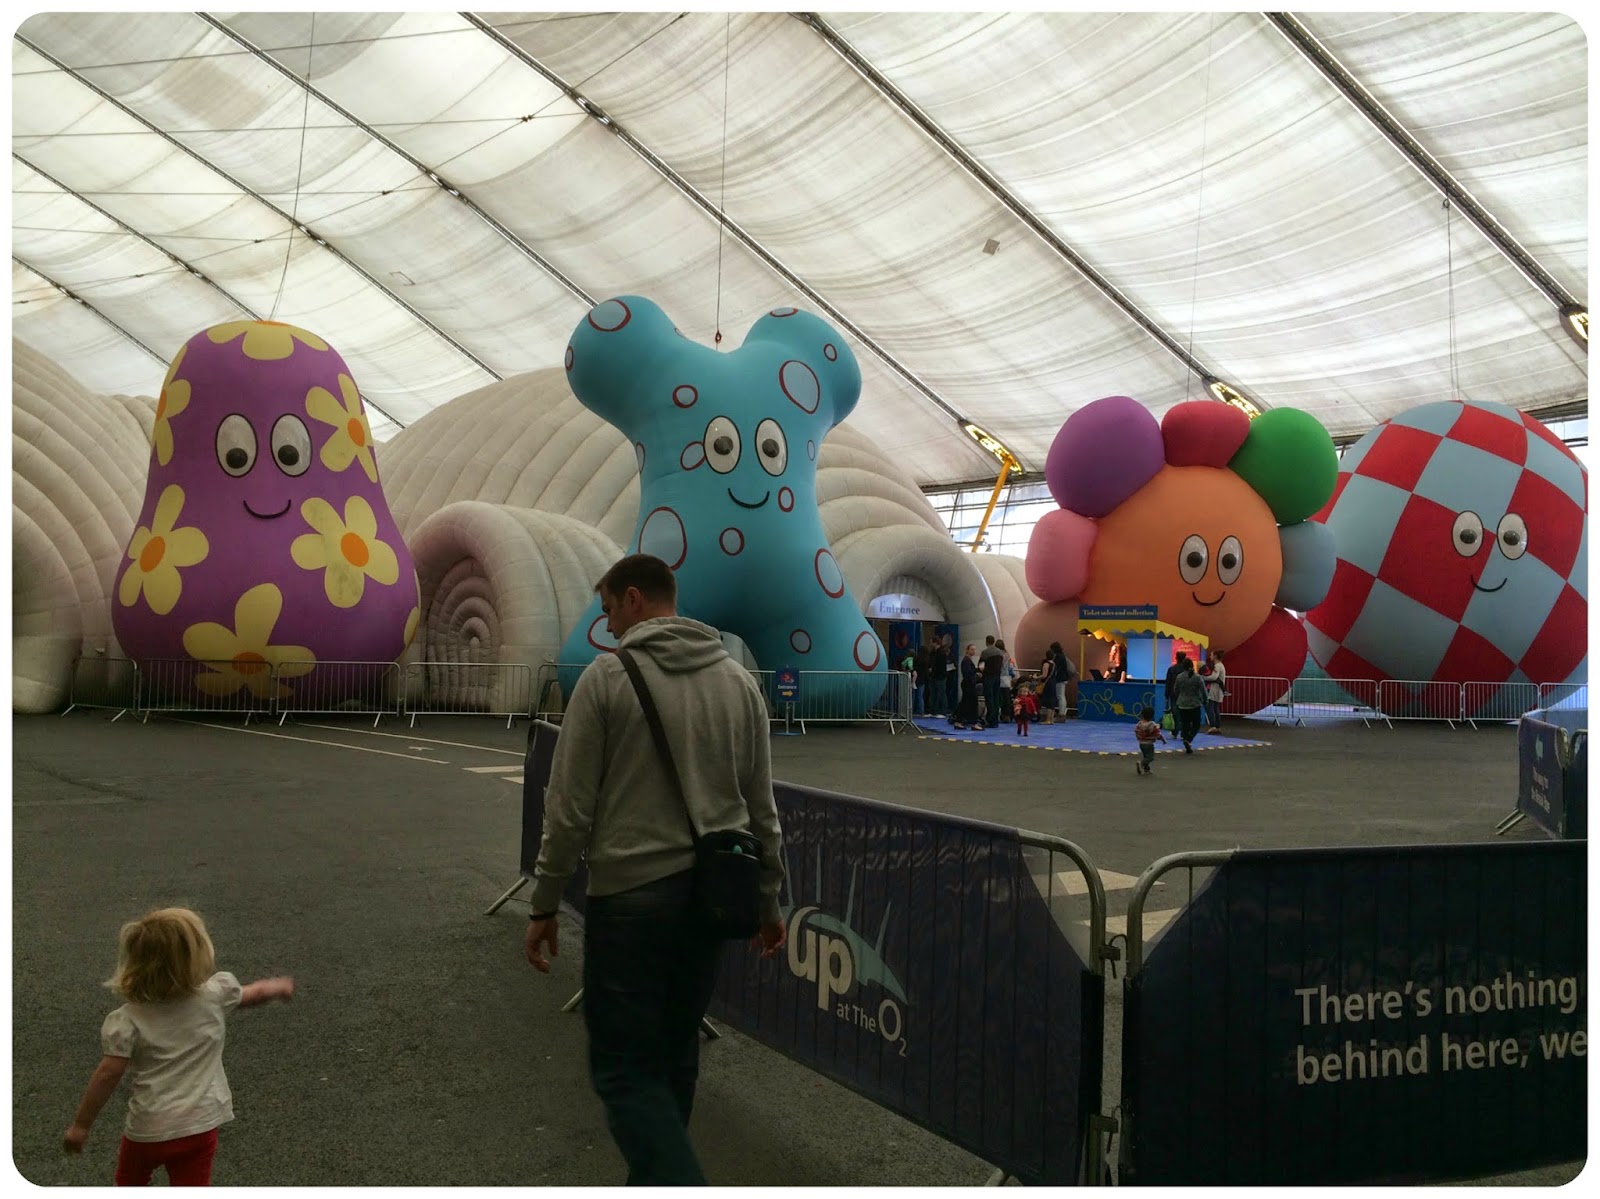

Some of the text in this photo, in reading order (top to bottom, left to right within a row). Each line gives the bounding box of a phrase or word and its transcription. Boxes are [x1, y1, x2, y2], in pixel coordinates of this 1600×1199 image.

[879, 601, 921, 614] Entrance
[787, 905, 853, 1012] up
[836, 1003, 850, 1021] at
[852, 1006, 877, 1033] The
[1294, 970, 1578, 1026] There's nothing
[1297, 1030, 1588, 1085] behind here, we
